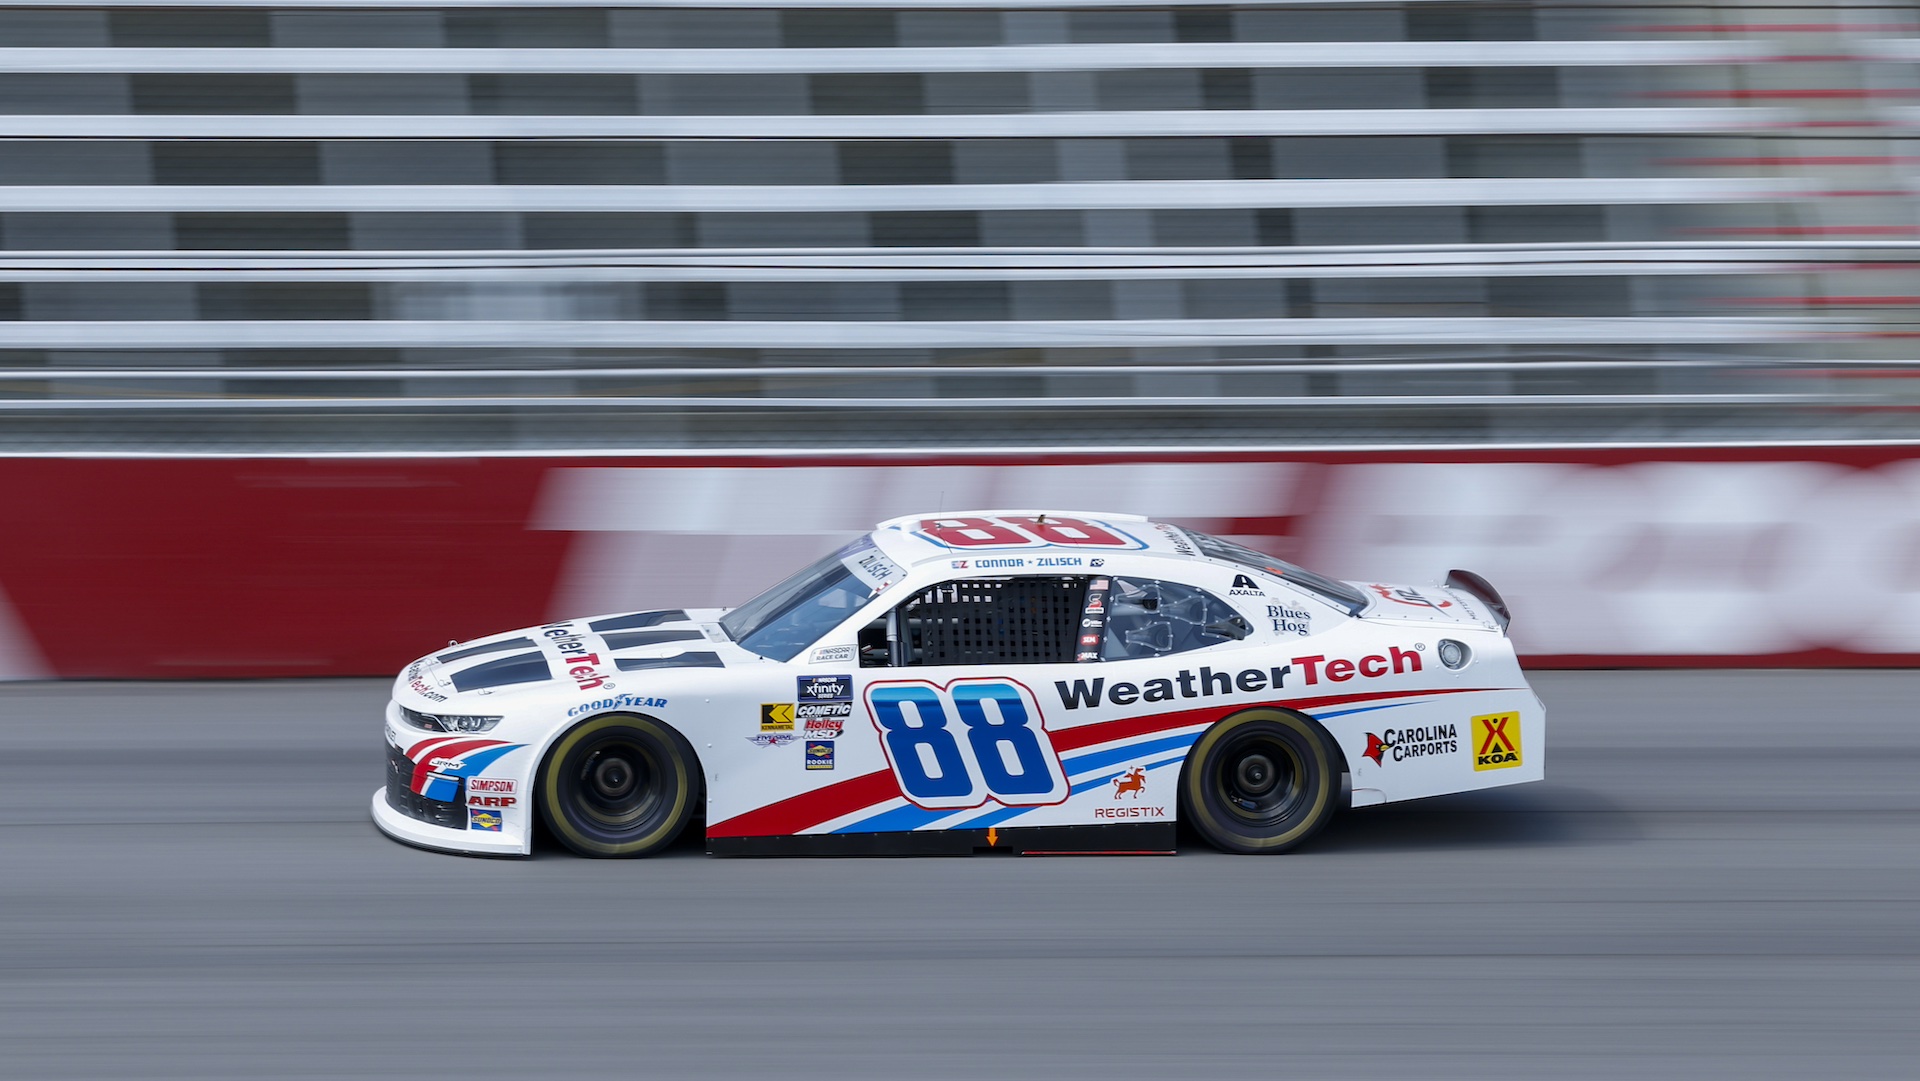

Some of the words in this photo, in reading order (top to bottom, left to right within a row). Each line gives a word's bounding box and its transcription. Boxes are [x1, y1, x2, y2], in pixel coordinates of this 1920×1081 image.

[919, 517, 1127, 546] 88
[975, 559, 1024, 568] CONNOR
[1036, 557, 1082, 566] ZILISCH
[1228, 588, 1266, 597] AXALTA
[1266, 605, 1311, 620] Blues
[1272, 619, 1307, 636] Hog
[541, 620, 612, 691] WeherTeh
[1054, 647, 1422, 710] WeatherTech
[806, 683, 844, 697] xfinity
[798, 704, 850, 715] COMETIC
[805, 719, 843, 730] Holley
[804, 730, 838, 739] MSD
[871, 683, 1055, 798] 88
[1384, 723, 1457, 748] CAROLINA
[1393, 740, 1457, 762] CARPORTS
[431, 760, 460, 769] JRM
[1478, 752, 1518, 765] KOA
[470, 780, 514, 793] SIMPSON
[467, 796, 517, 807] ARP
[1094, 807, 1165, 819] REGISTIX
[473, 816, 501, 824] SUNOCO
